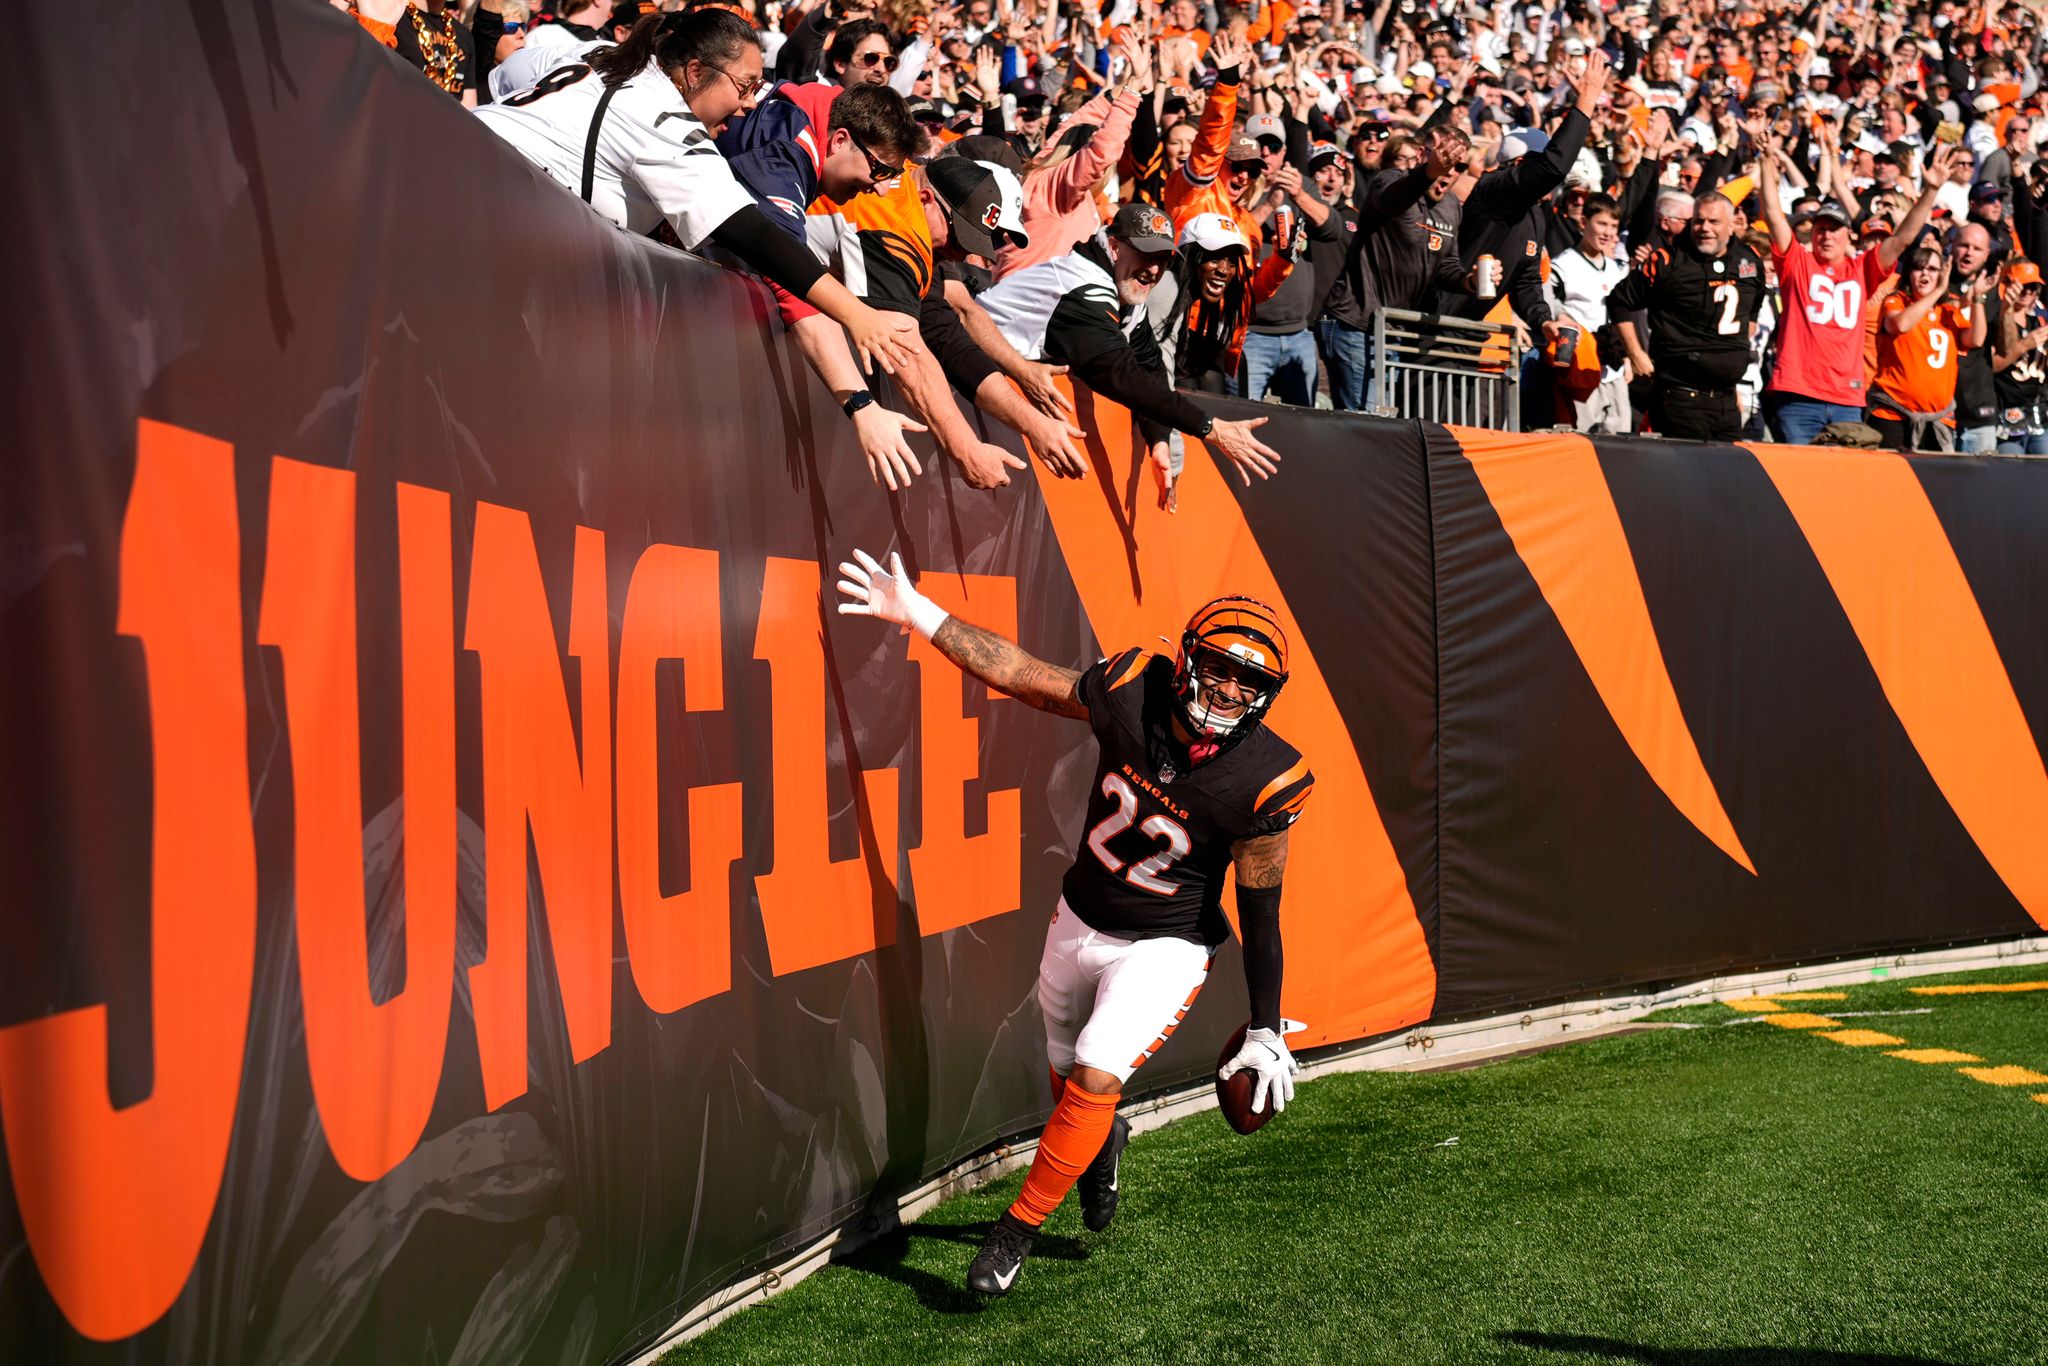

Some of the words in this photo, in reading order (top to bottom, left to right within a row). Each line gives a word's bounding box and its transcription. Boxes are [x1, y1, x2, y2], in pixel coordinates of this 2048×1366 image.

[1713, 284, 1741, 336] 2
[1806, 273, 1861, 330] 50
[1927, 328, 1949, 369] 9
[1122, 763, 1189, 820] BENGALS
[1087, 771, 1192, 897] 22
[0, 418, 1021, 1341] JUNGLE
